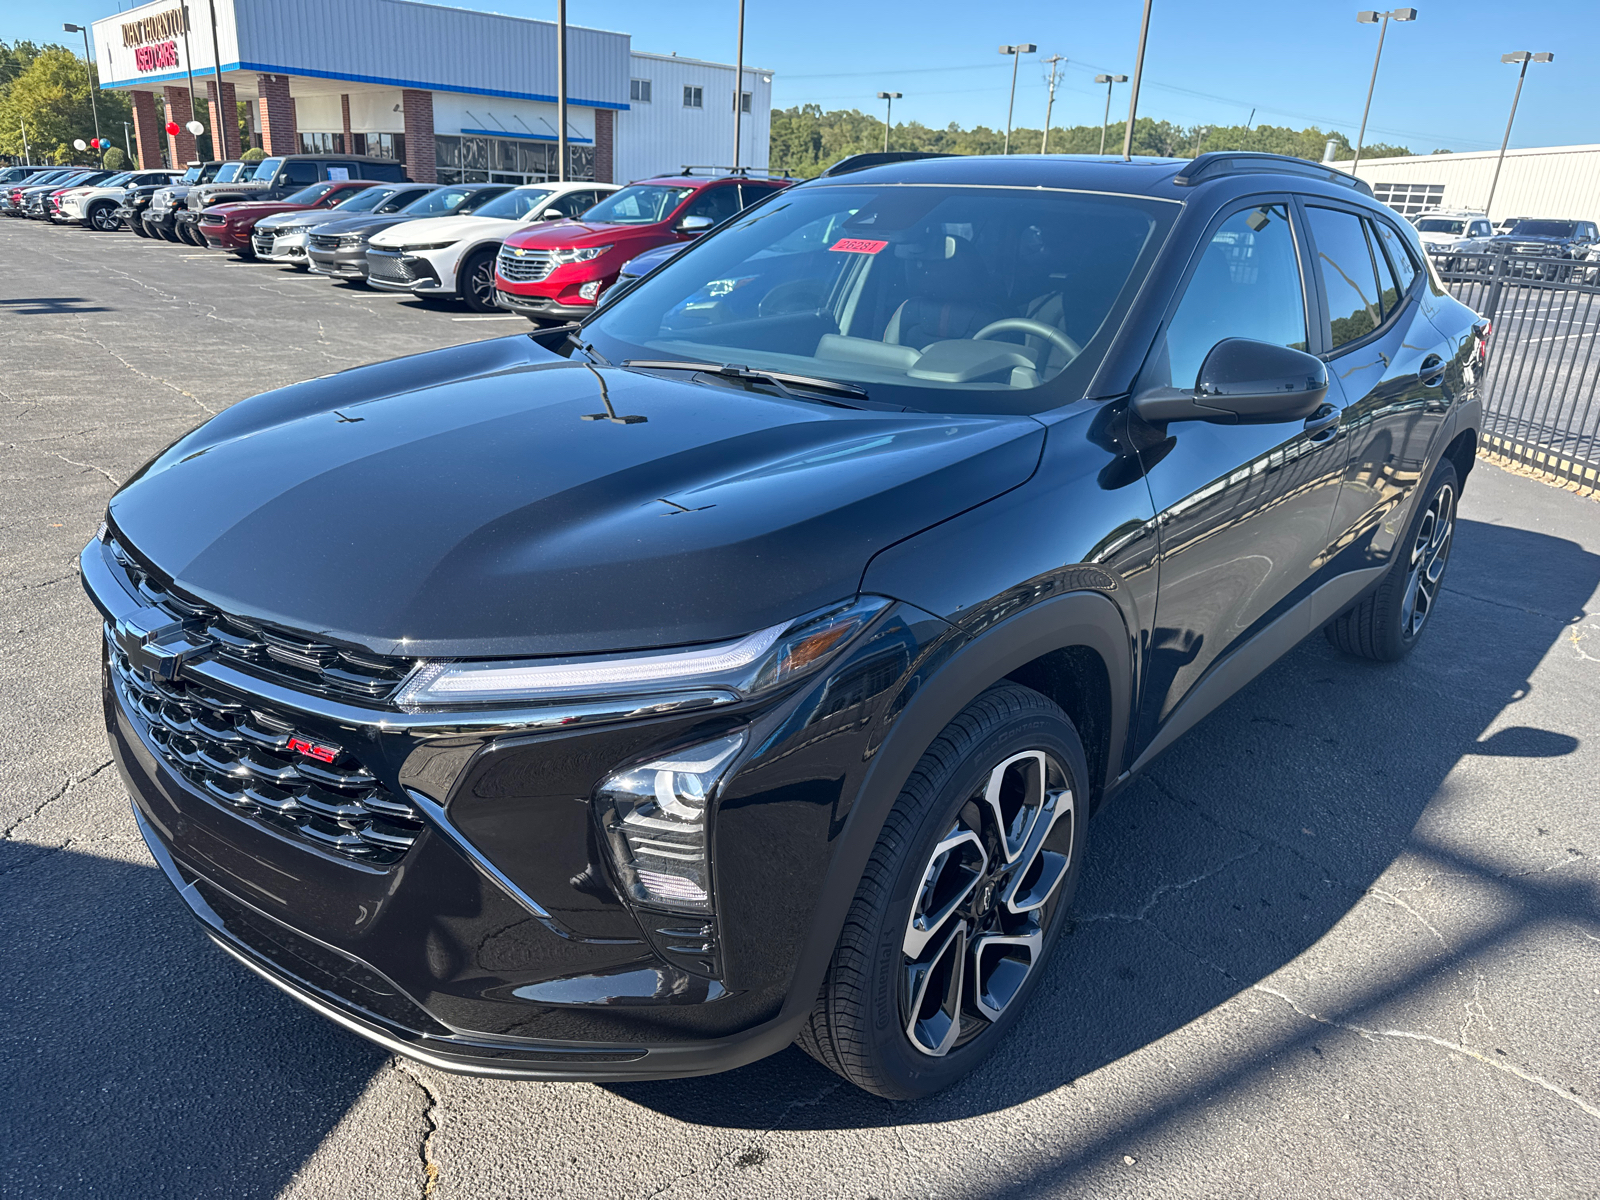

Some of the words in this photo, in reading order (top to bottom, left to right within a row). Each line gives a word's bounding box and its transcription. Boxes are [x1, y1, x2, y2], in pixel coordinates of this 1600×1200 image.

[135, 46, 154, 71] USED
[154, 41, 176, 68] CARS
[838, 240, 878, 251] 26281
[286, 738, 336, 763] RS
[874, 941, 893, 1031] Continental
